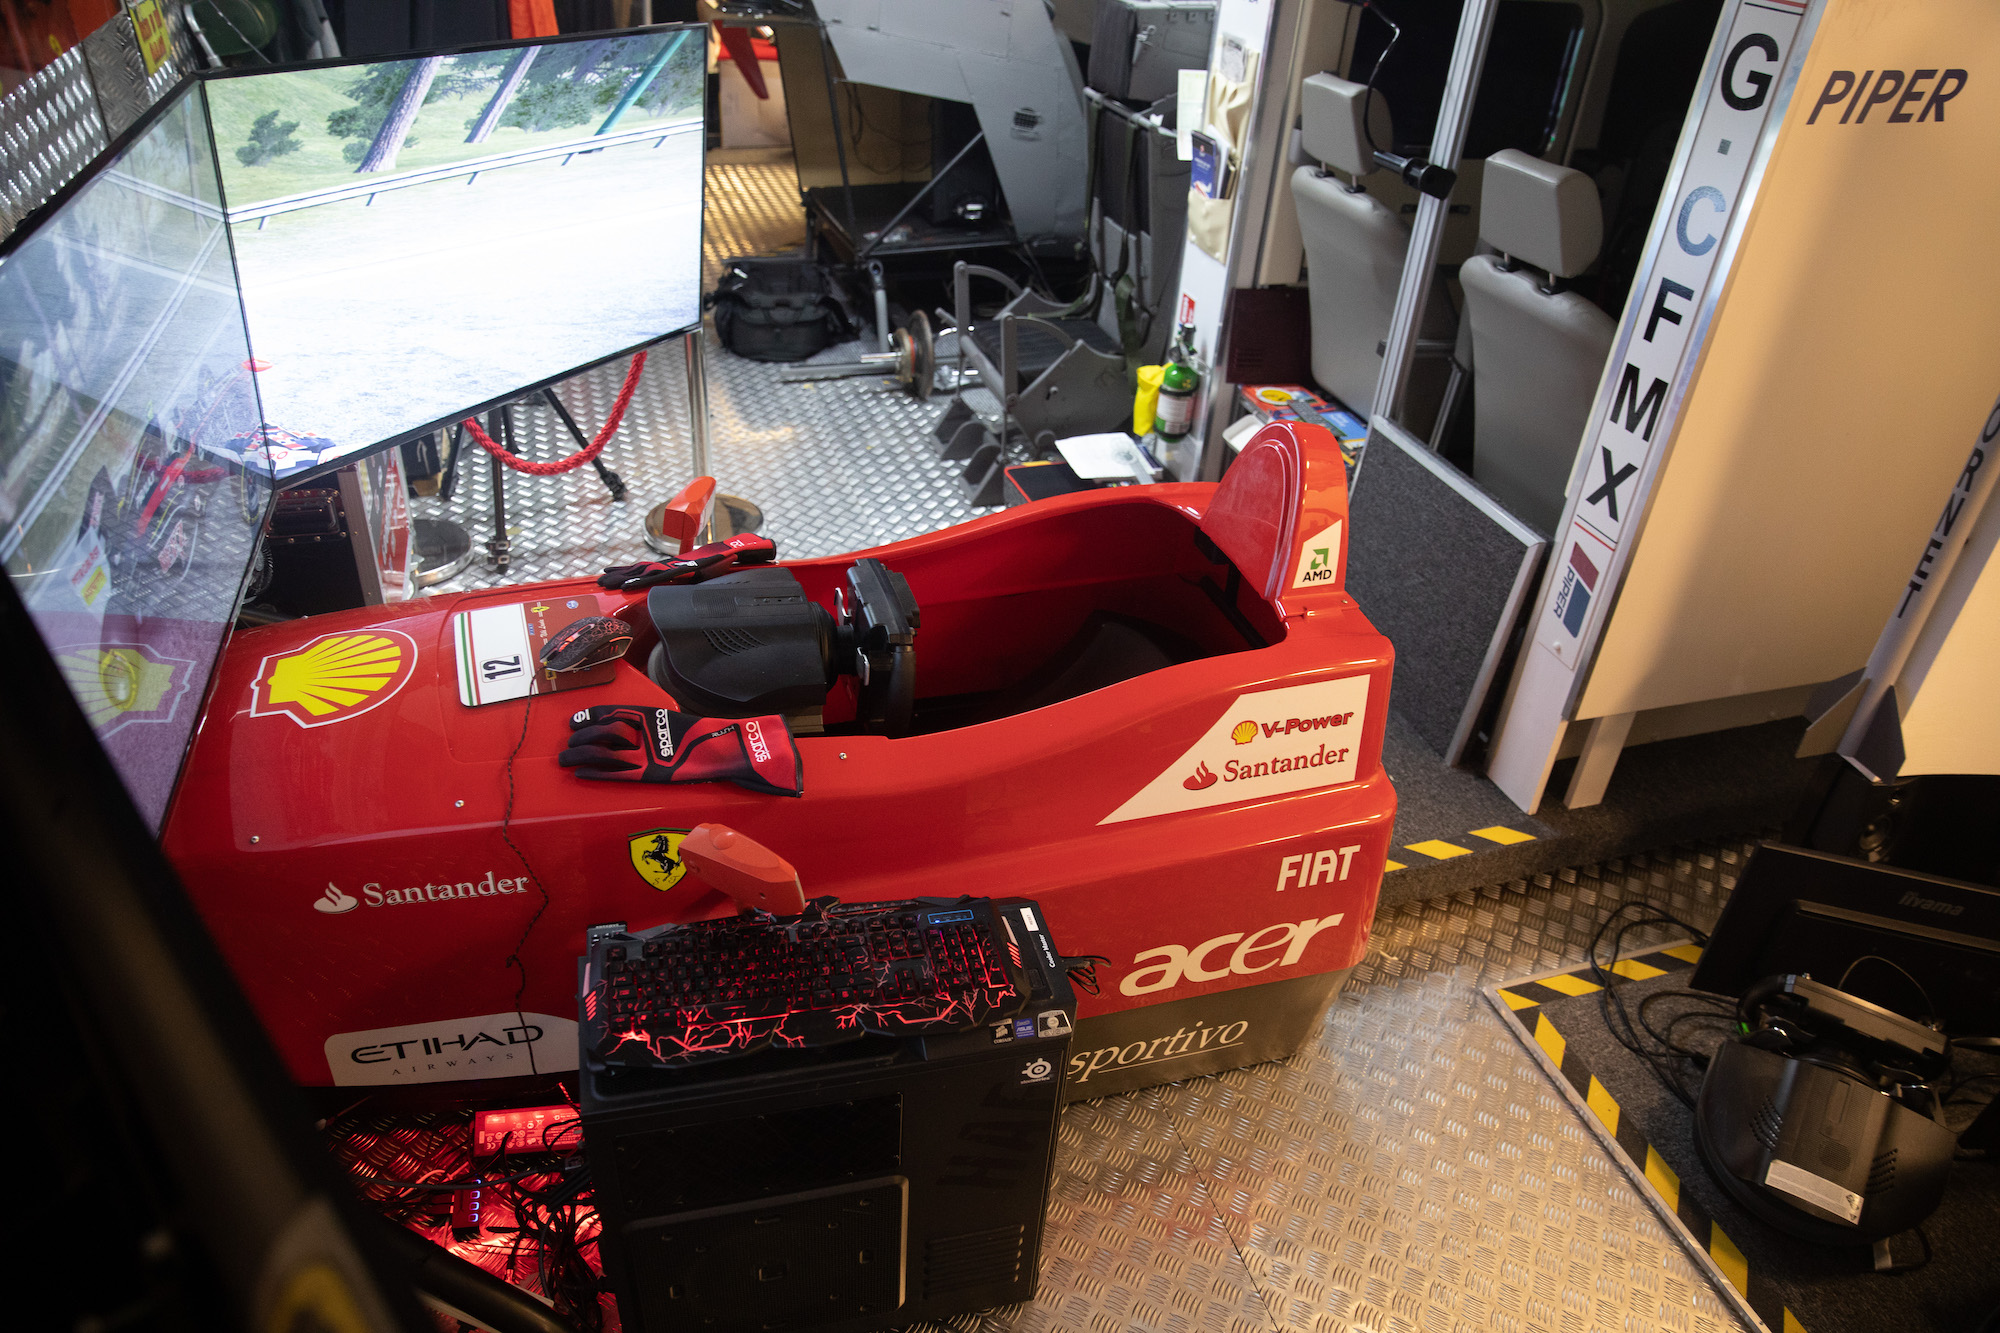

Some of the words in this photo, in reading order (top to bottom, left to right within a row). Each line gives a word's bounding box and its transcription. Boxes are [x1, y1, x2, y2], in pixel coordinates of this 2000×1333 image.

[1805, 68, 1969, 126] PIPER
[1302, 569, 1332, 583] AMD
[1553, 565, 1575, 619] PIPER
[482, 655, 523, 680] 12
[655, 708, 674, 758] sparco
[745, 720, 771, 763] sparco
[1261, 711, 1355, 739] V-Power
[1223, 743, 1350, 783] Santander
[1276, 844, 1362, 892] FIAT
[363, 871, 530, 908] Santander
[1046, 951, 1056, 968] Cooler
[1119, 912, 1345, 997] acer
[350, 1024, 544, 1064] ETIHAD
[391, 1052, 514, 1075] AIRWAYS
[1067, 1020, 1250, 1084] sportivo
